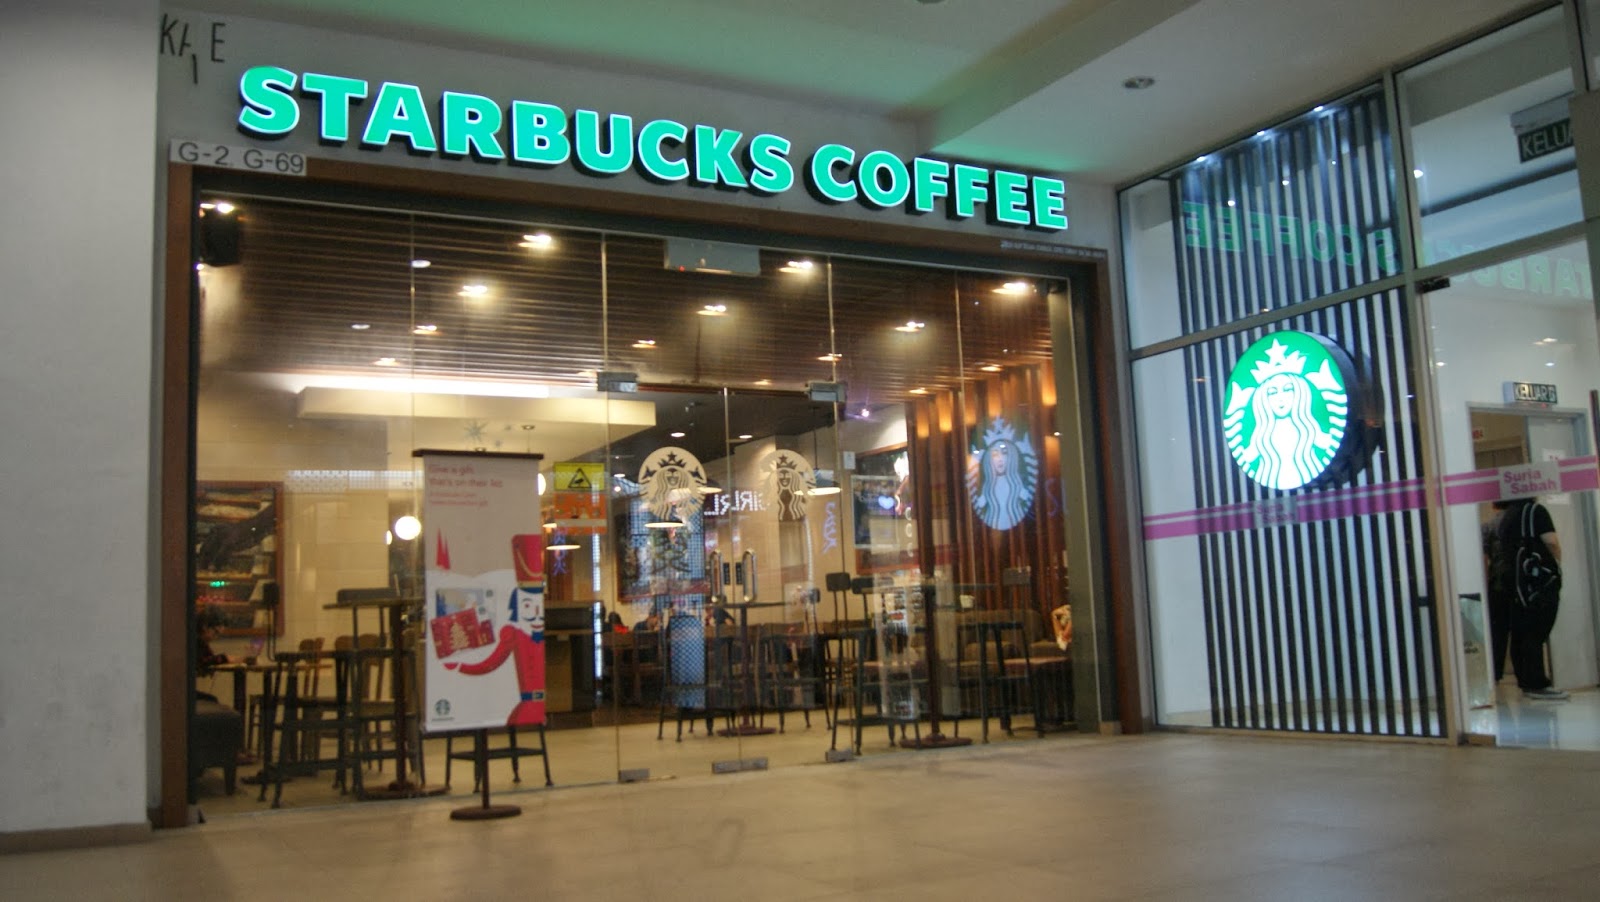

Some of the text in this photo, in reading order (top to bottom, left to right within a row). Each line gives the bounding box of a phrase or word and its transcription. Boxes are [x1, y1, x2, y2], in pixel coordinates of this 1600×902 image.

[239, 66, 1069, 230] STARBUCKS COFFEE
[243, 149, 304, 174] G-69
[1503, 469, 1542, 484] Suria
[1510, 479, 1557, 495] Sabah
